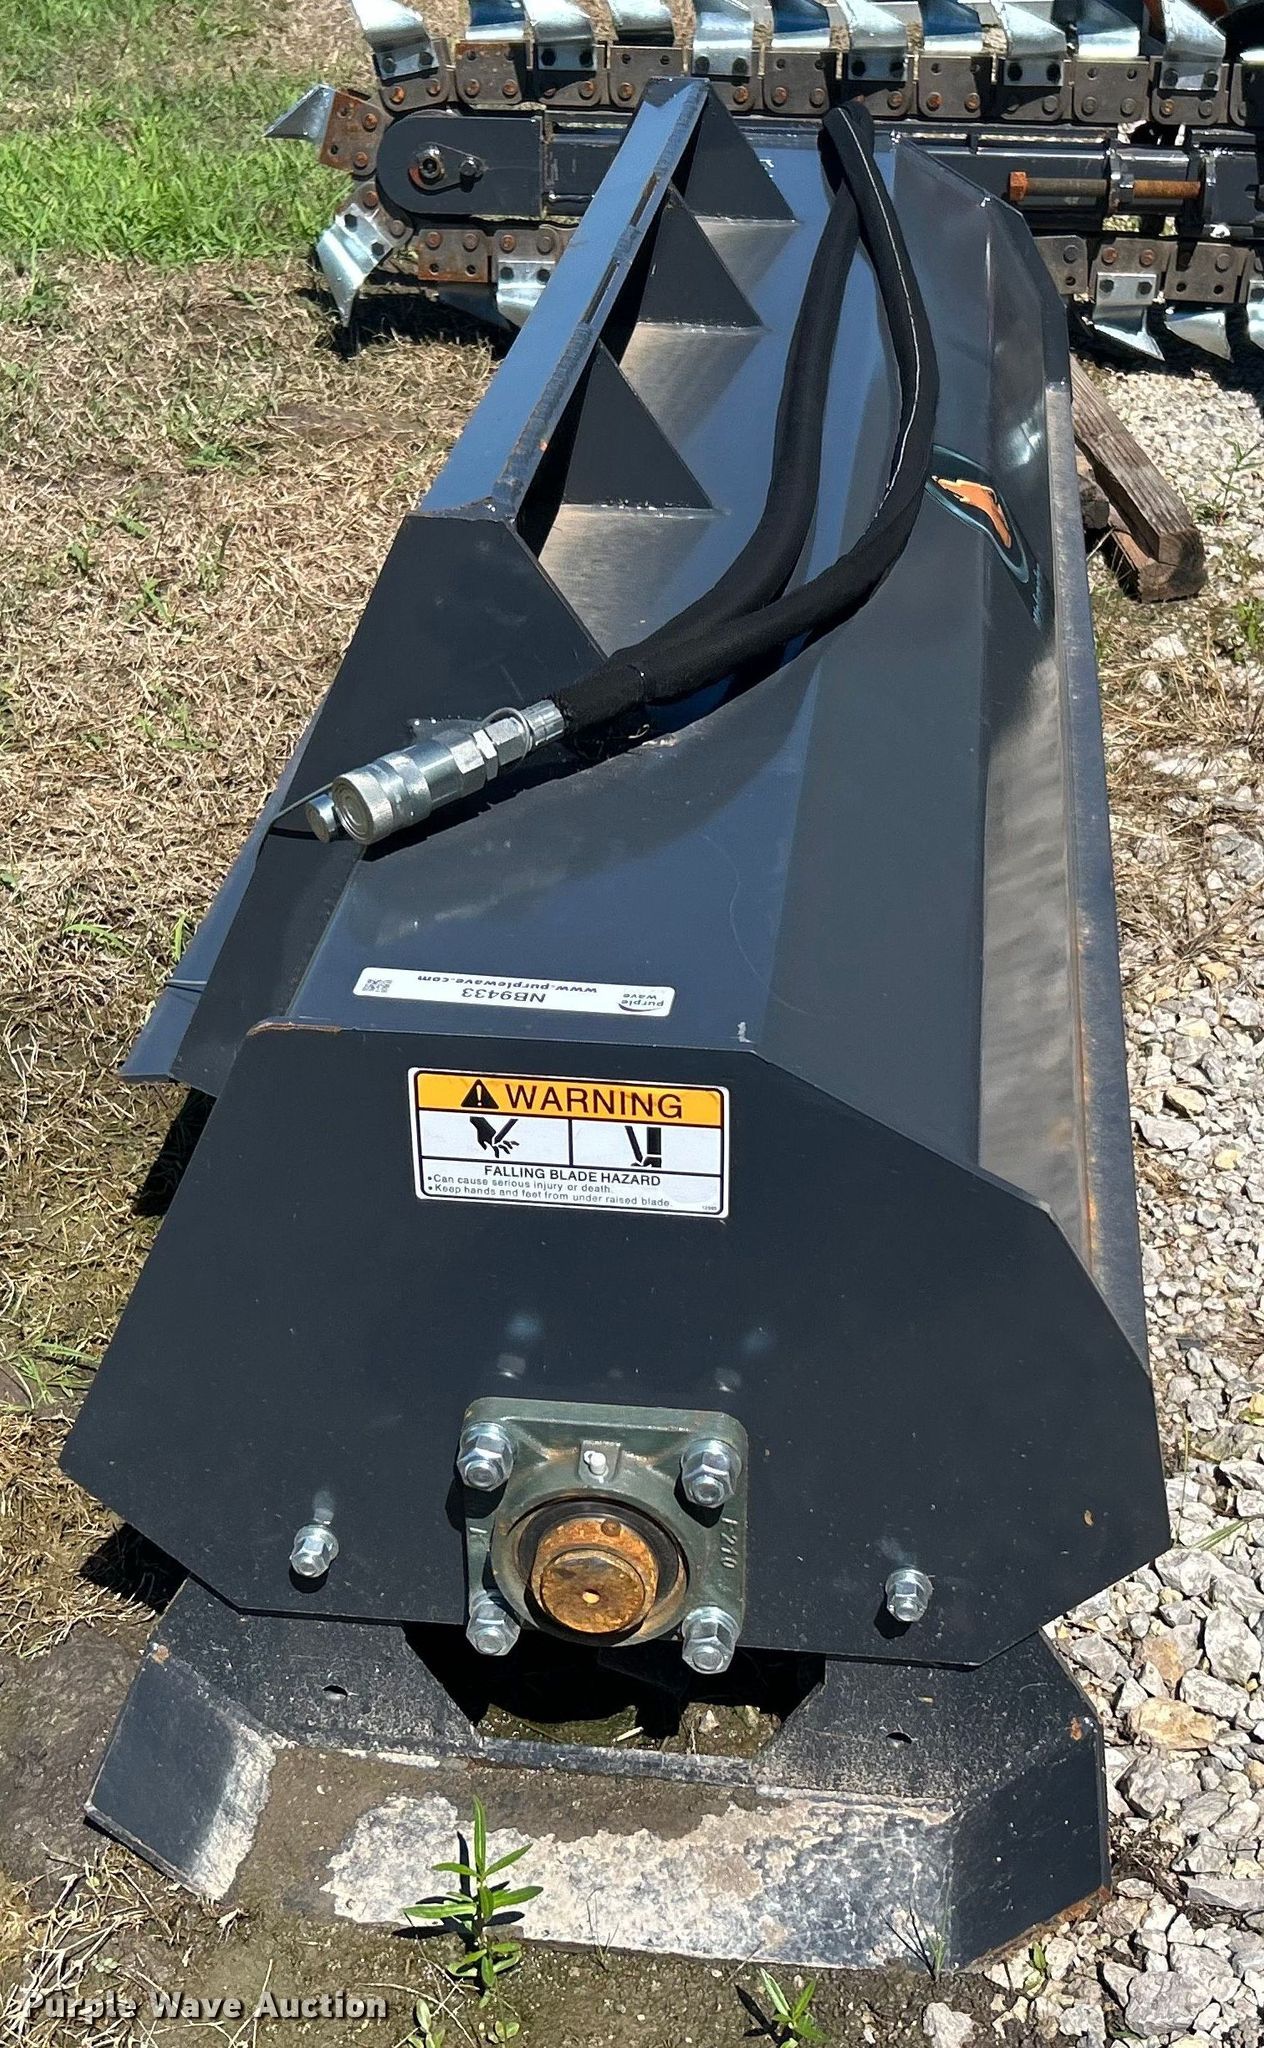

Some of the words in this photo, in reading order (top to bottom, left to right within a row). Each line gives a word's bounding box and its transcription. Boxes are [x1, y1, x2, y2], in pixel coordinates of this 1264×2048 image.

[417, 975, 598, 994] www.purplewave.com
[461, 987, 546, 1003] NB9433
[621, 998, 664, 1008] purple
[505, 1083, 683, 1119] WARNING
[433, 1174, 455, 1184] Can
[457, 1177, 488, 1186] cause
[492, 1178, 531, 1189] serious
[533, 1180, 563, 1192] injury
[567, 1184, 579, 1192] or
[484, 1165, 546, 1180] FALLING
[549, 1168, 599, 1183] BLADE
[600, 1172, 661, 1187] HAZARD
[435, 1184, 462, 1195] Keep
[464, 1186, 496, 1196] hands
[499, 1188, 519, 1198] and
[521, 1189, 542, 1199] feet
[544, 1190, 569, 1201] from
[573, 1193, 602, 1204] under
[605, 1195, 638, 1206] raised
[641, 1196, 674, 1208] blade.
